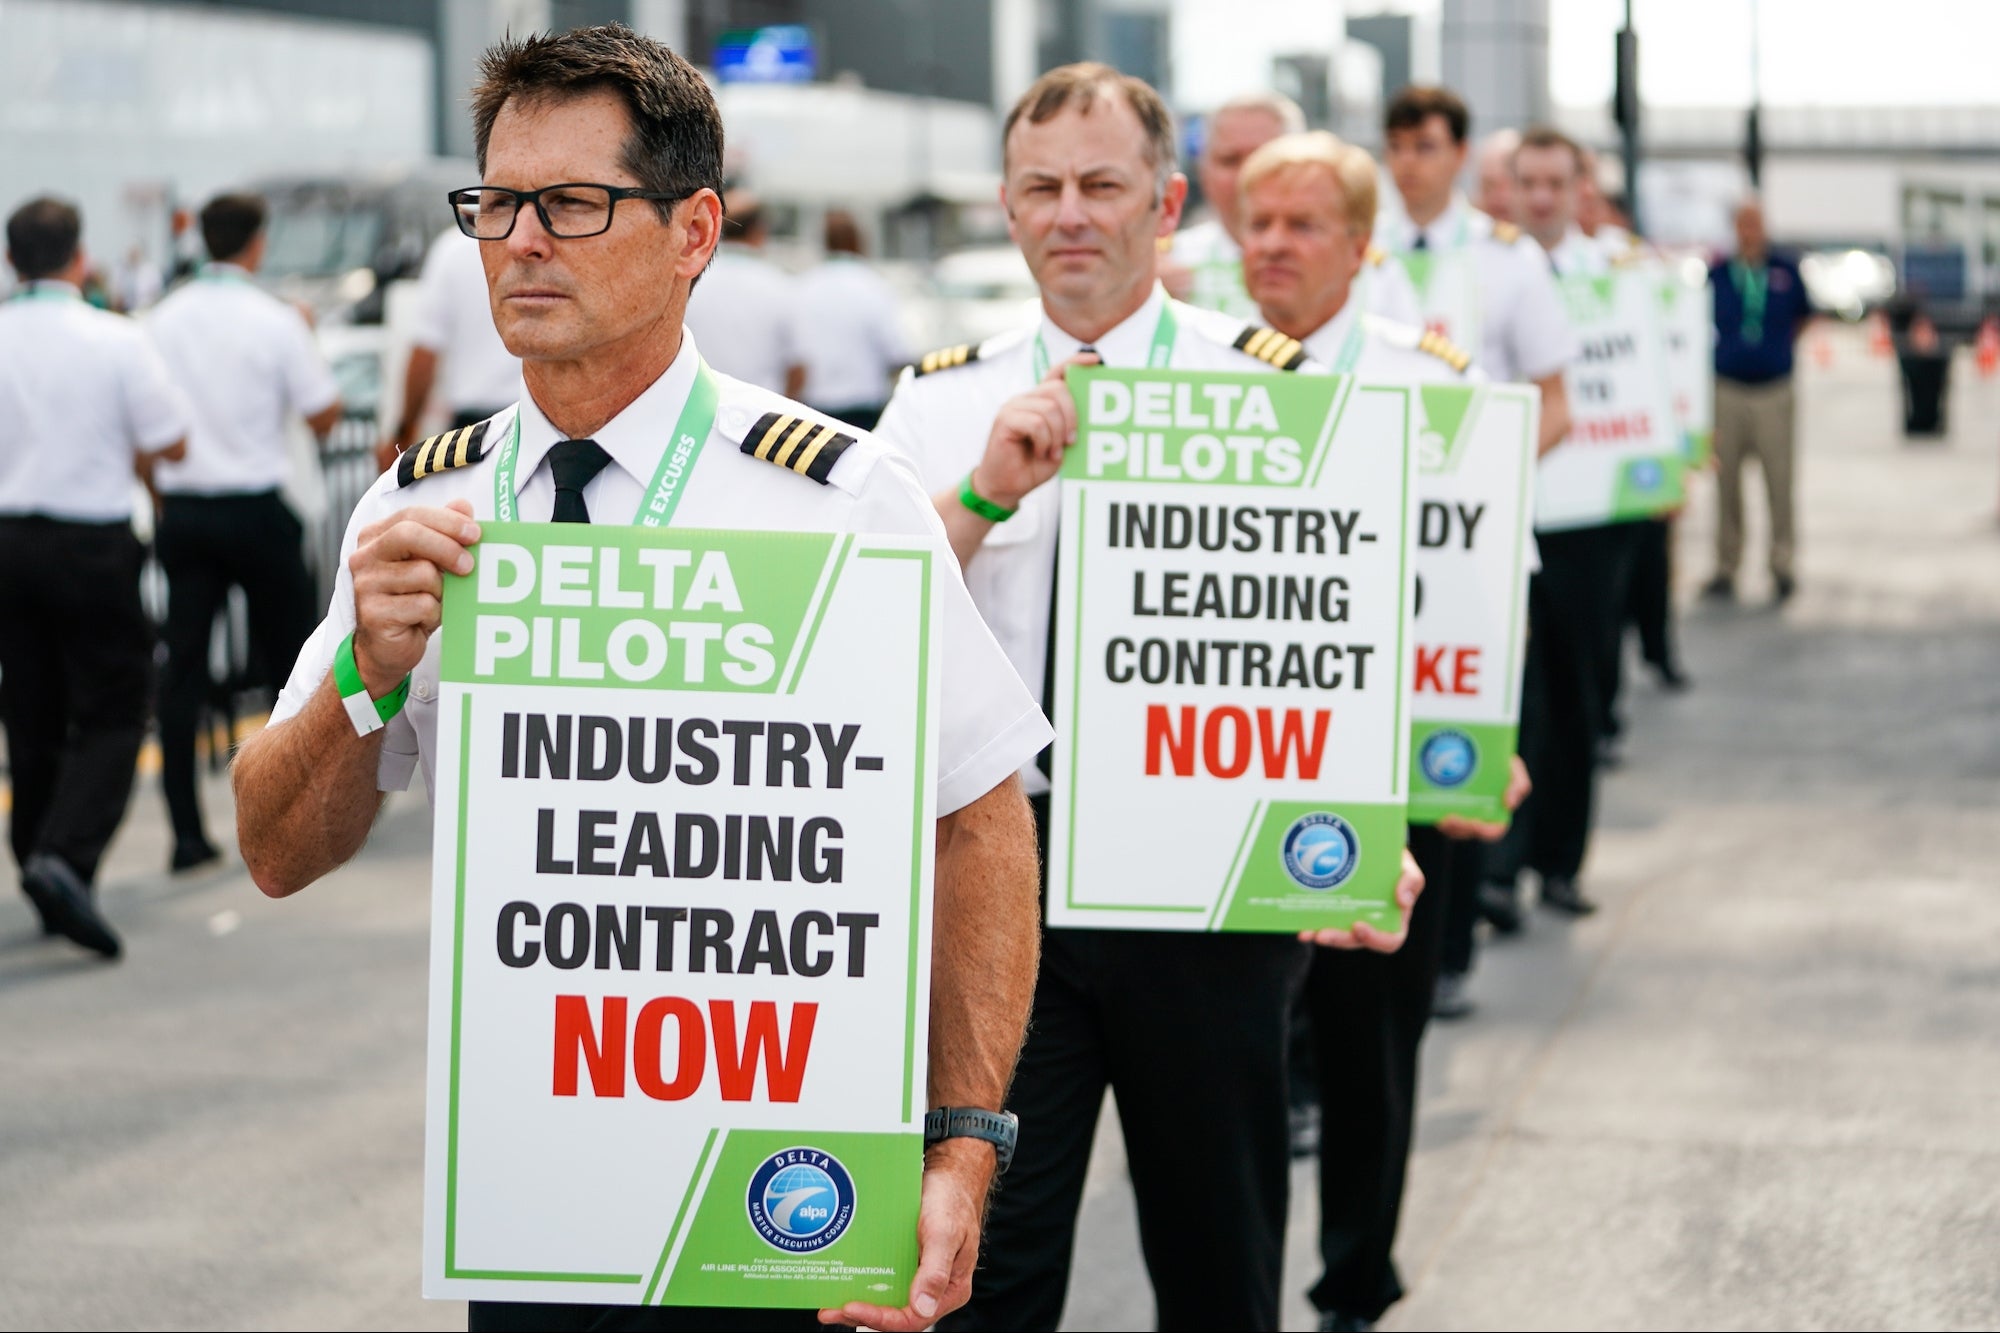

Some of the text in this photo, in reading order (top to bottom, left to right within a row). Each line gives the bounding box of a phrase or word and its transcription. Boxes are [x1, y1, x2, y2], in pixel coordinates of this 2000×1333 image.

[1088, 380, 1279, 432] DELTA
[650, 433, 696, 514] EXCUSES
[1087, 431, 1303, 484] PILOTS
[499, 471, 512, 522] ACTIO
[1108, 503, 1378, 555] INDUSTRY-
[477, 543, 744, 611] DELTA
[1133, 571, 1350, 623] LEADING
[474, 614, 776, 686] PILOTS
[1105, 637, 1375, 690] CONTRACT
[501, 712, 884, 790] INDUSTRY-
[1144, 704, 1332, 781] NOW
[535, 808, 844, 884] LEADING
[496, 900, 880, 978] CONTRACT
[552, 994, 819, 1104] NOW
[775, 1151, 830, 1169] DELTA
[752, 1202, 850, 1248] MASTER EXECUTIVE COUNCIL
[799, 1205, 828, 1221] alpa
[701, 1263, 896, 1275] AIR LINE PILOTS ASSOCIATION, INTERNATIONAL
